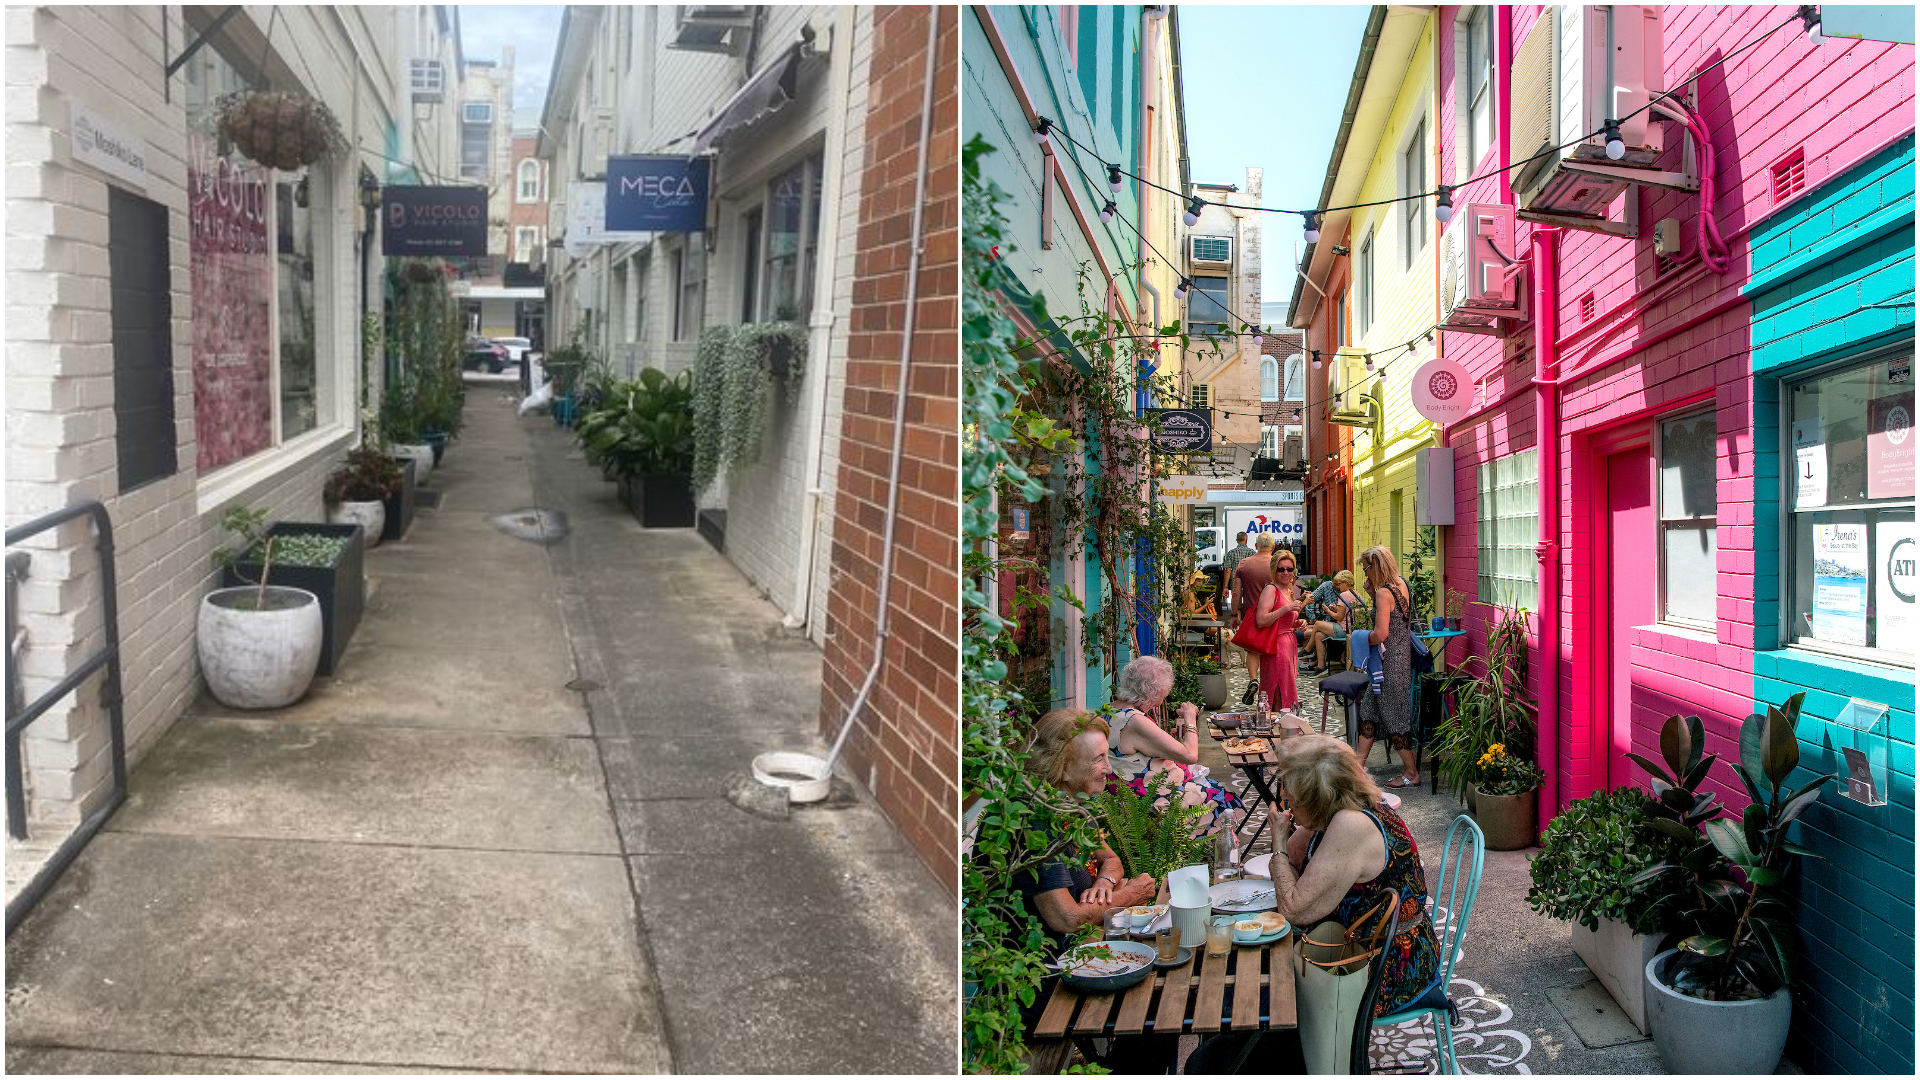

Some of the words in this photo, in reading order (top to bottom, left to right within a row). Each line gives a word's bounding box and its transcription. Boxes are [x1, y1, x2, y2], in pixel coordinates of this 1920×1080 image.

[620, 175, 695, 197] MECA
[414, 205, 480, 219] VICOLO
[1426, 404, 1442, 412] Body
[1442, 404, 1461, 412] Bright
[1160, 485, 1205, 500] happly
